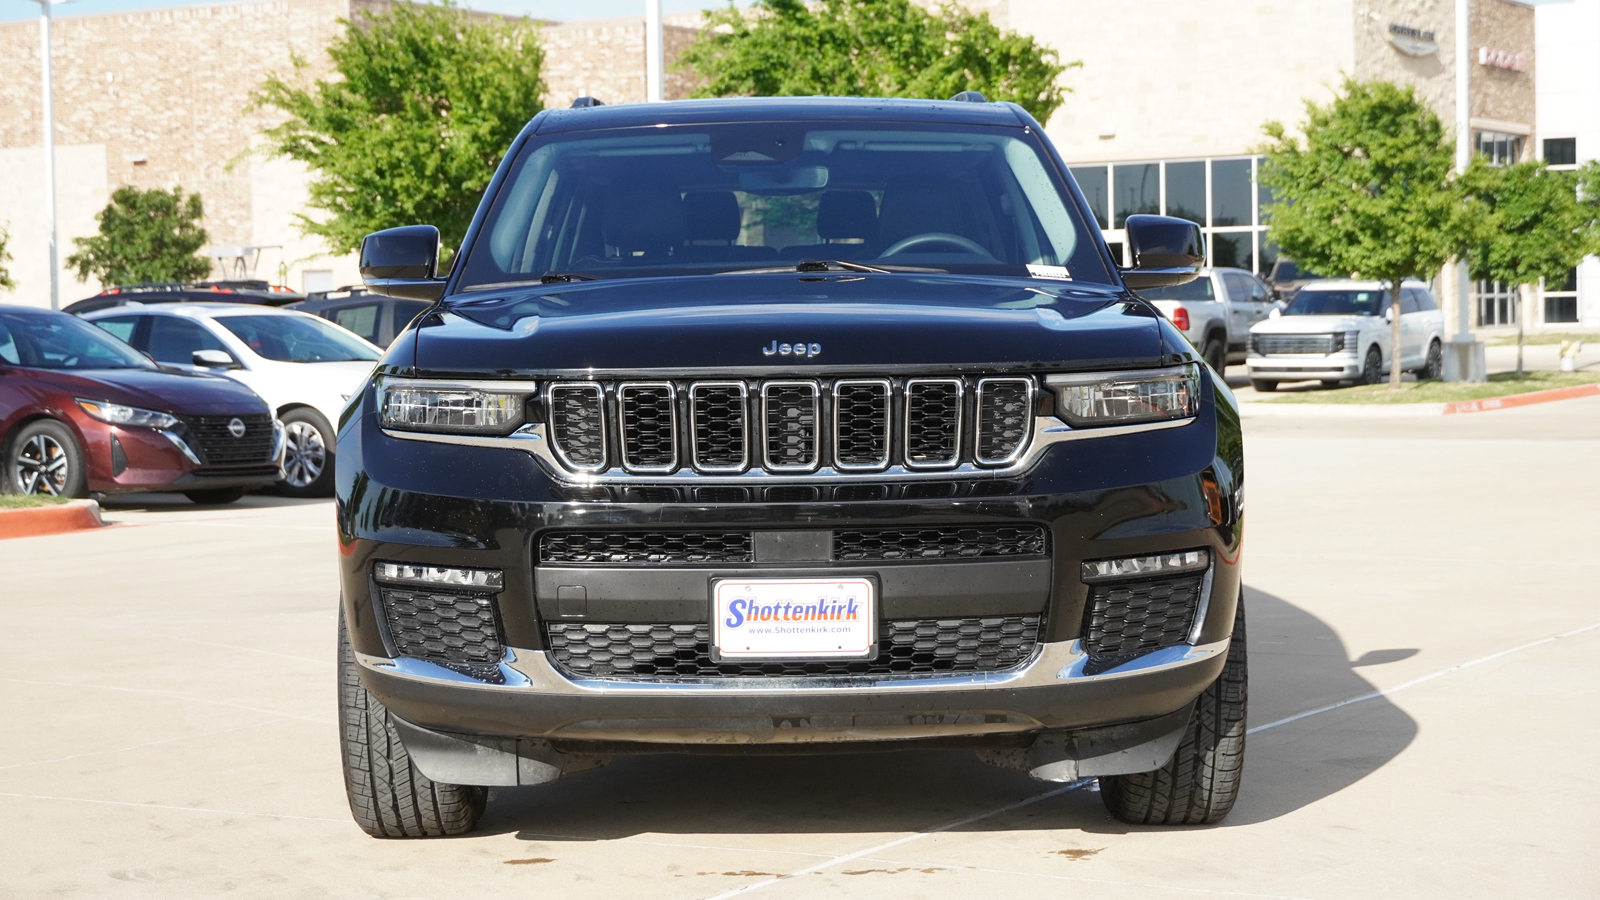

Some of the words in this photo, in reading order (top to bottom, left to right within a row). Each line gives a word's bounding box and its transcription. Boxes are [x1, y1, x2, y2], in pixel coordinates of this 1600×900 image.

[762, 339, 822, 358] Jeep
[726, 598, 859, 628] Shottenkirk
[748, 626, 851, 634] www.Shottenkirk.com
